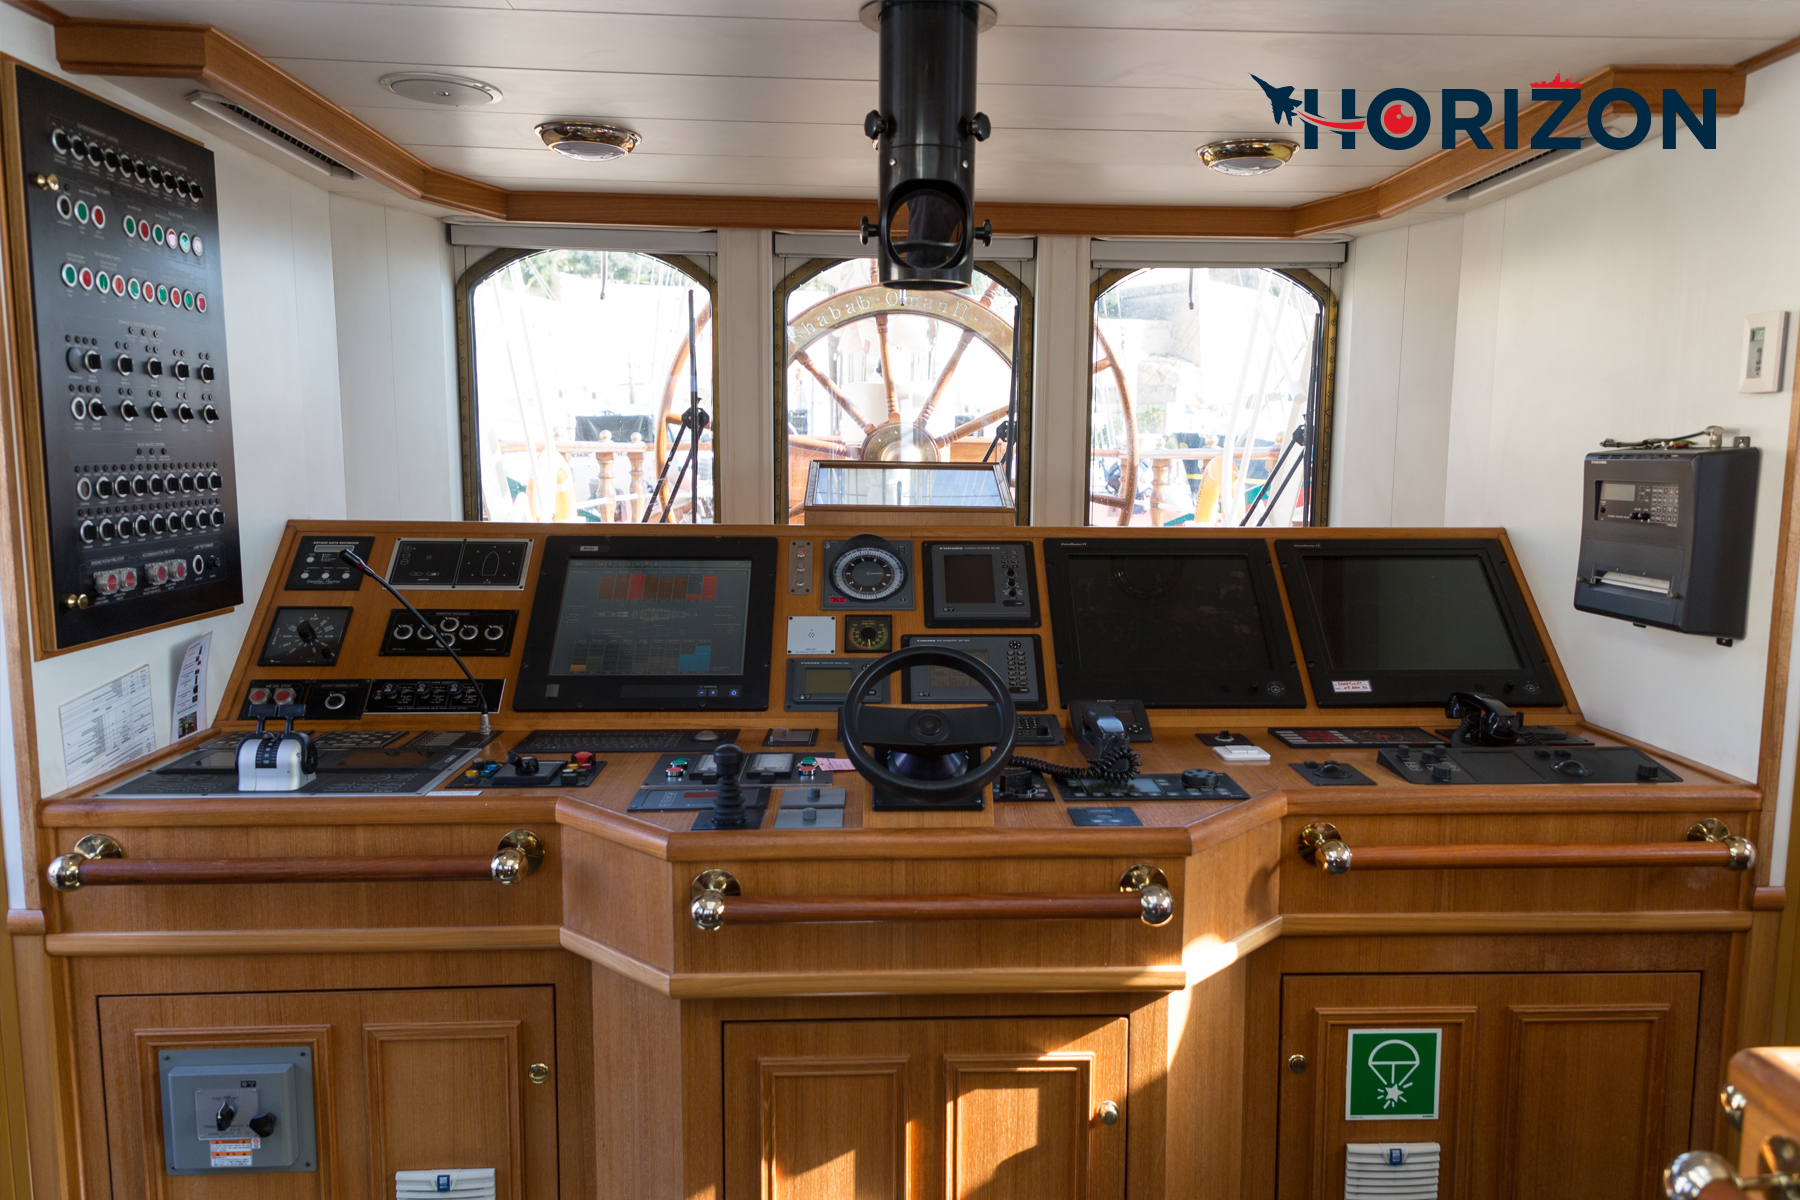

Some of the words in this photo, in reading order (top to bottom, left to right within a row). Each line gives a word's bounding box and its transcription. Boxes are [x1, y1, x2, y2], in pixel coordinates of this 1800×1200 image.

[788, 295, 872, 344] Shabab
[885, 290, 948, 313] Oman
[952, 301, 971, 321] II
